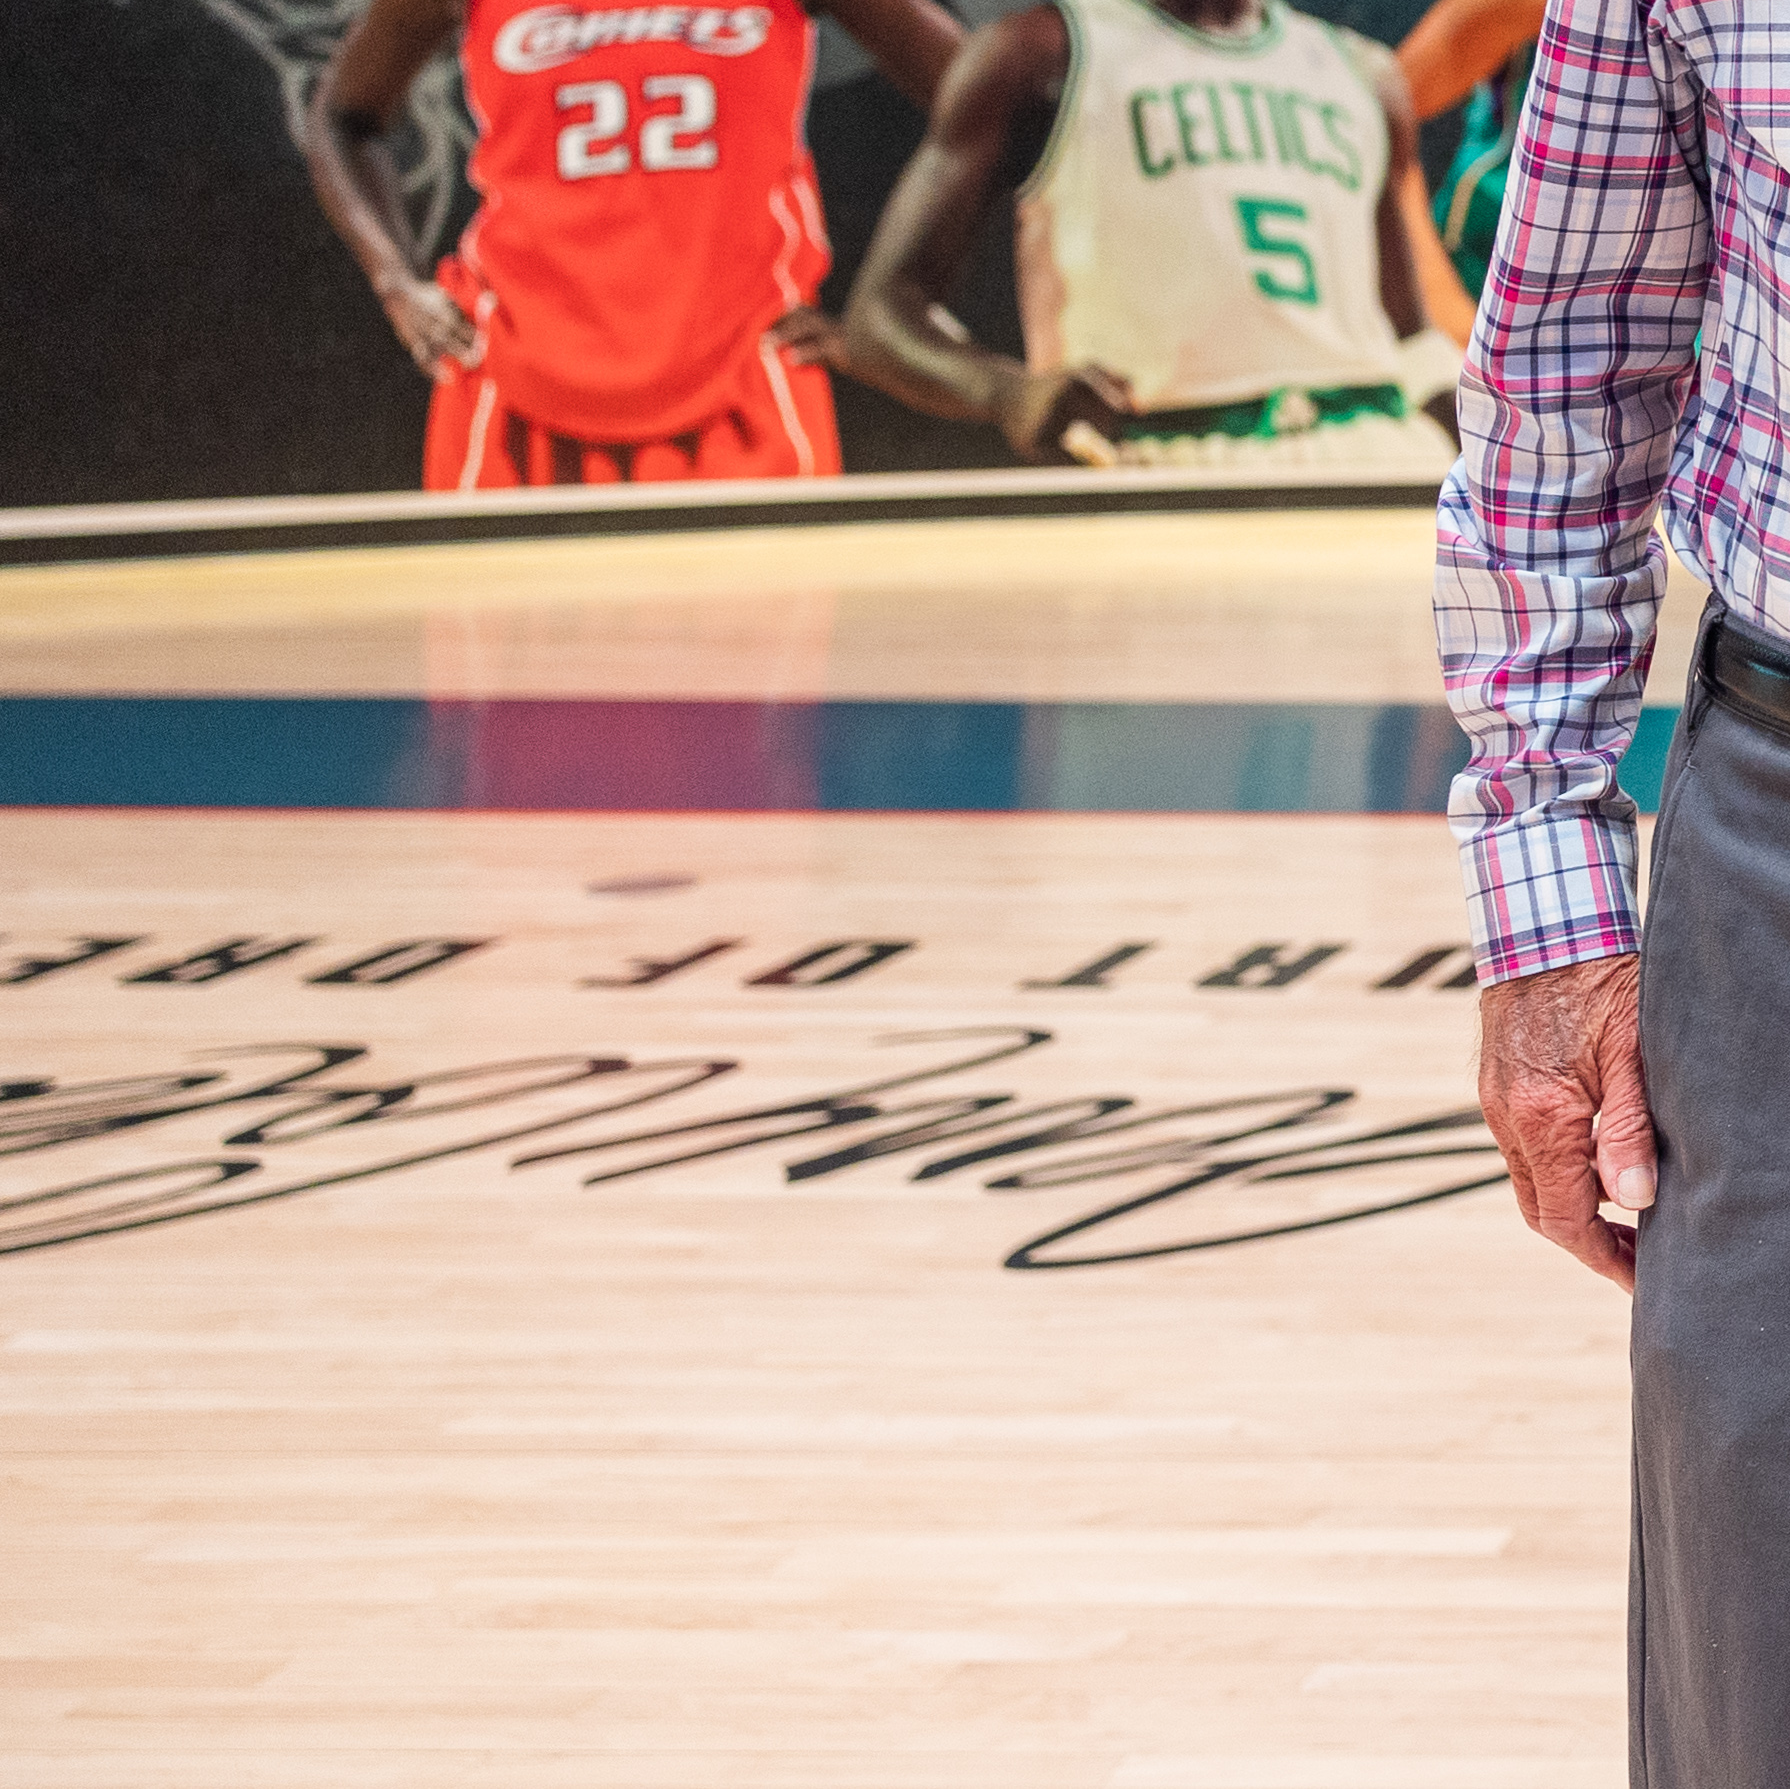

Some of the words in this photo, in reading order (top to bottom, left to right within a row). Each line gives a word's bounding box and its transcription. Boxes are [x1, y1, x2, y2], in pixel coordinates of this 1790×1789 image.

[555, 73, 720, 182] 22
[1127, 79, 1363, 193] CELTICS
[1232, 194, 1322, 307] 5
